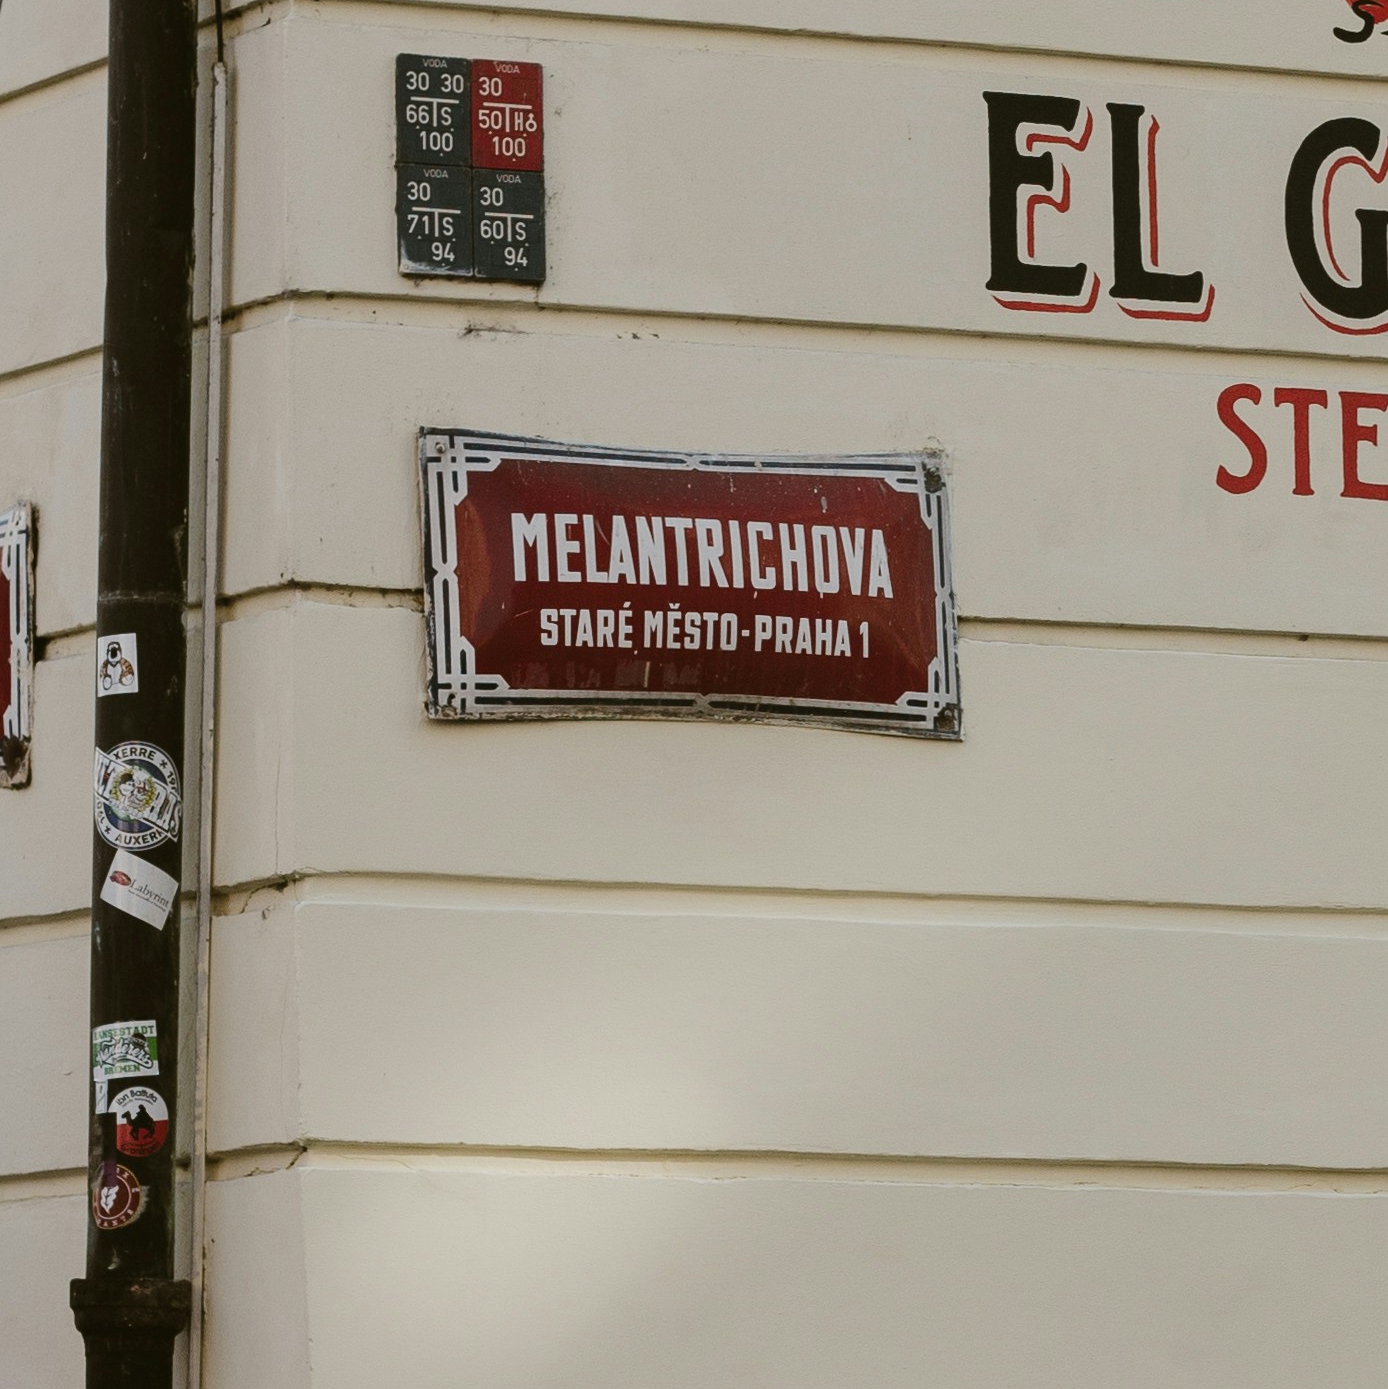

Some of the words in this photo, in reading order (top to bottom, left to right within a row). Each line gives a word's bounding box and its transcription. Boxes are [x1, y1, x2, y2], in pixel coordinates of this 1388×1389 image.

[423, 59, 448, 68] VODA
[495, 64, 520, 74] VODA
[406, 72, 429, 90] 30
[440, 74, 464, 93] 30
[479, 77, 502, 96] 30
[406, 105, 429, 123] 66
[442, 107, 452, 125] S
[479, 110, 502, 129] 50
[419, 132, 453, 151] 100
[493, 136, 526, 156] 100
[424, 169, 448, 178] VODA
[496, 175, 521, 184] VODA
[407, 182, 430, 201] 30
[480, 188, 503, 206] 30
[983, 91, 1216, 322] EL
[407, 215, 429, 234] 71
[443, 218, 453, 236] S
[480, 221, 503, 239] 60
[516, 222, 526, 240] S
[432, 242, 455, 261] 94
[504, 248, 528, 266] 94
[511, 512, 894, 599] MELANTRICHOVA
[540, 601, 633, 648] STARÉ
[859, 622, 869, 658] 1
